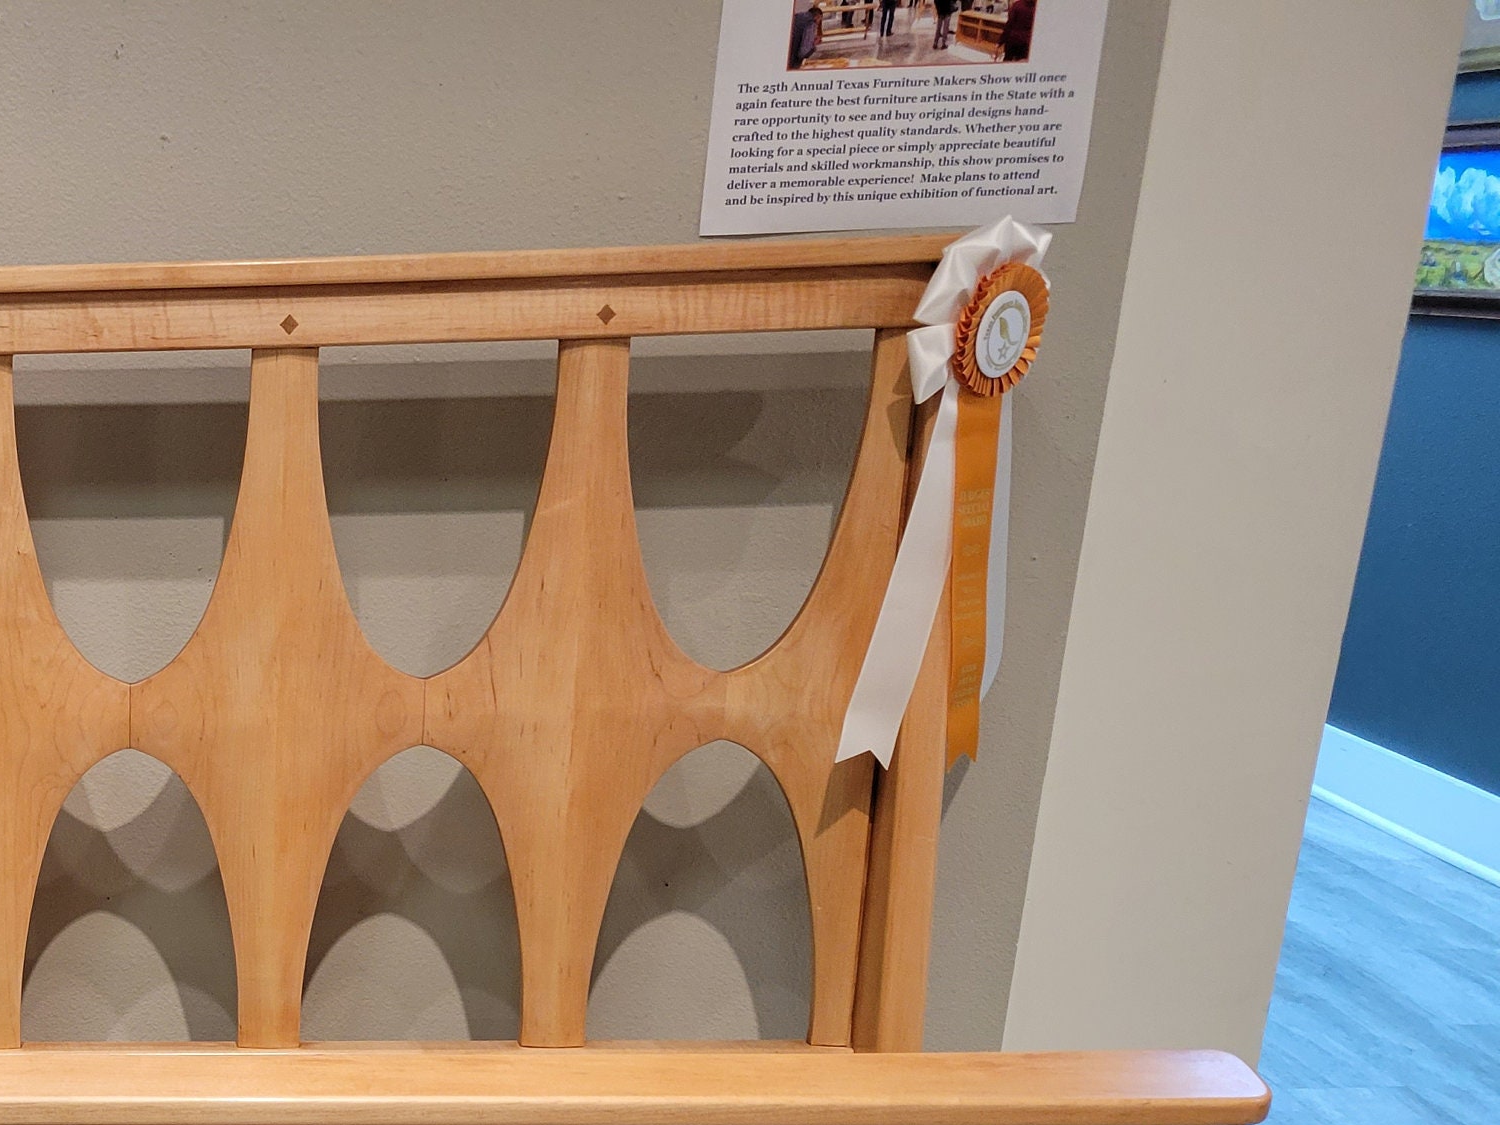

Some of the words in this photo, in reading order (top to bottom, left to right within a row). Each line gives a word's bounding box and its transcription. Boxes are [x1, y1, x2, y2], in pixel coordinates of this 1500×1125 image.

[736, 83, 759, 93] The
[761, 81, 788, 94] 25th
[790, 80, 833, 91] Annual
[835, 79, 869, 89] Texas
[872, 77, 930, 88] Furniture
[932, 75, 976, 86] Makers
[978, 74, 1012, 84] Show
[1014, 72, 1036, 83] will
[1038, 74, 1066, 82] once
[735, 99, 767, 112] again
[770, 98, 812, 108] feature
[815, 96, 834, 107] the
[836, 96, 860, 106] best
[862, 94, 918, 105] furniture
[919, 92, 967, 103] artisans
[970, 91, 982, 101] in
[985, 90, 1004, 100] the
[1006, 90, 1036, 99] State
[1039, 87, 1065, 98] with
[733, 117, 759, 126] rare
[761, 112, 832, 127] opportunity
[833, 113, 846, 122] to
[847, 113, 867, 122] see
[869, 110, 892, 121] and
[894, 109, 916, 122] buy
[918, 107, 965, 121] original
[967, 106, 1011, 119] designs
[1014, 104, 1048, 116] hand-
[731, 130, 773, 142] crafted
[776, 131, 788, 140] to
[790, 129, 809, 140] the
[811, 128, 854, 141] highest
[856, 126, 898, 140] quality
[899, 124, 961, 136] standards.
[964, 122, 1016, 133] Whether
[1017, 123, 1040, 134] you
[1042, 123, 1062, 131] are
[730, 147, 774, 161] looking
[777, 146, 794, 157] for
[805, 146, 846, 156] special
[848, 143, 879, 156] piece
[881, 144, 895, 153] or
[896, 143, 937, 152] simply
[938, 138, 1000, 153] appreciate
[1002, 136, 1057, 149] beautiful
[728, 162, 784, 174] materials
[785, 161, 808, 172] and
[810, 159, 849, 171] skilled
[851, 157, 935, 169] workmanship,
[937, 155, 960, 166] this
[962, 155, 993, 165] show
[994, 153, 1049, 167] promises
[1052, 153, 1064, 163] to
[726, 179, 768, 190] deliver
[779, 176, 845, 188] memorable
[847, 173, 914, 188] experience!
[919, 172, 952, 183] Make
[953, 171, 986, 184] plans
[988, 171, 1000, 180] to
[1002, 168, 1040, 180] attend
[724, 195, 749, 205] and
[749, 195, 764, 205] be
[765, 193, 814, 206] inspired
[816, 192, 831, 204] by
[832, 191, 854, 202] this
[856, 190, 897, 202] unique
[899, 188, 958, 199] exhibition
[960, 187, 975, 197] of
[975, 184, 1035, 196] functional
[1036, 185, 1057, 194] art.
